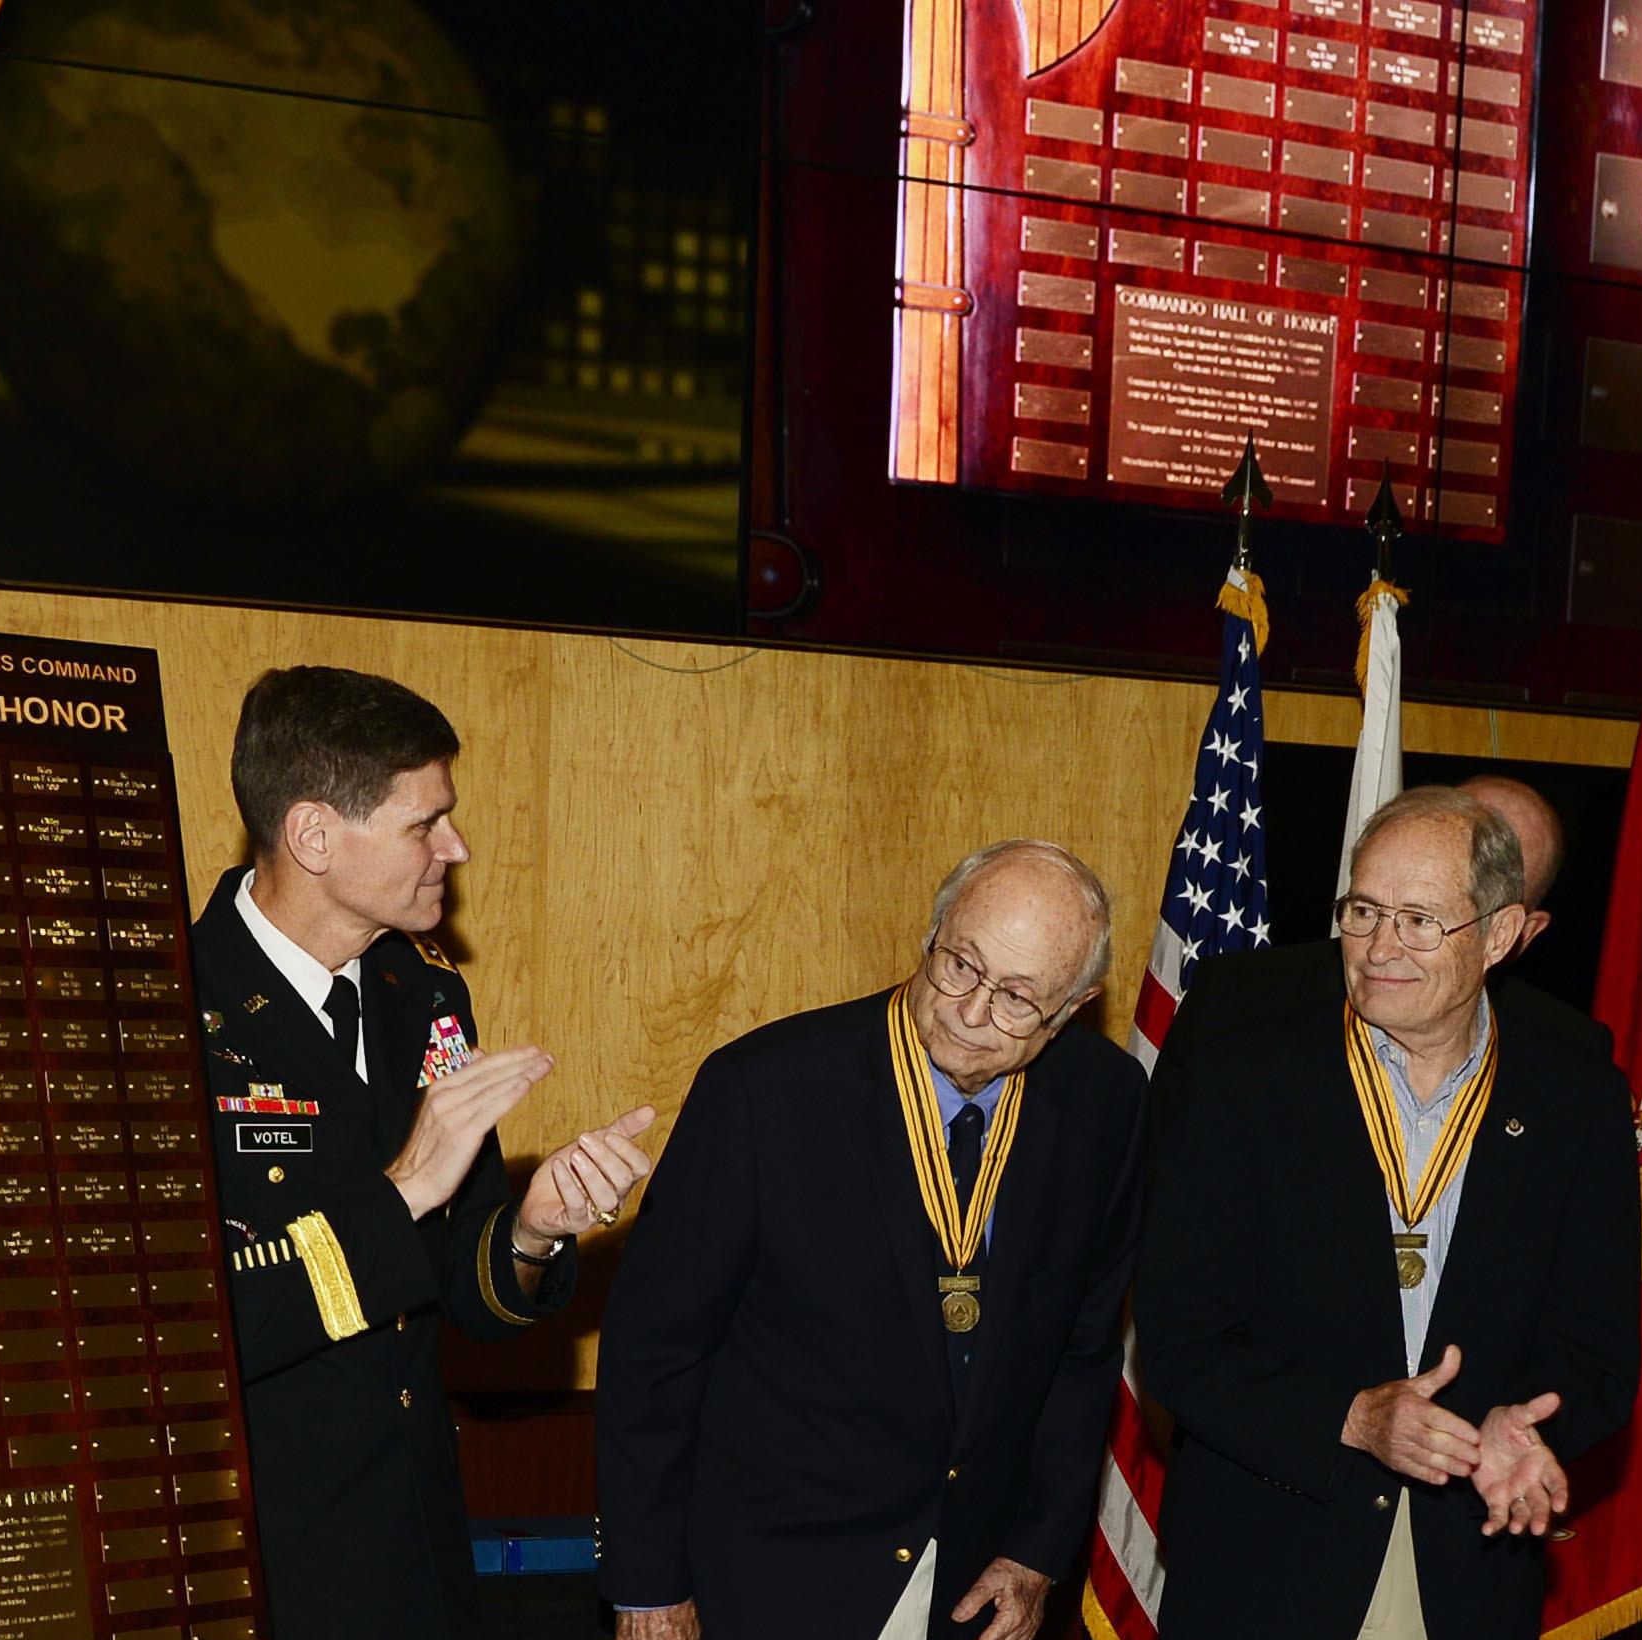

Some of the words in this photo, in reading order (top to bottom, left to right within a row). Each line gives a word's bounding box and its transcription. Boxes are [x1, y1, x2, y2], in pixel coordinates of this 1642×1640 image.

[1119, 290, 1206, 316] COMMANDO
[1212, 303, 1249, 323] HALL
[1256, 310, 1278, 326] OF
[22, 656, 137, 685] COMMAND
[253, 1132, 298, 1145] VOTEL
[24, 1488, 75, 1505] HONOR
